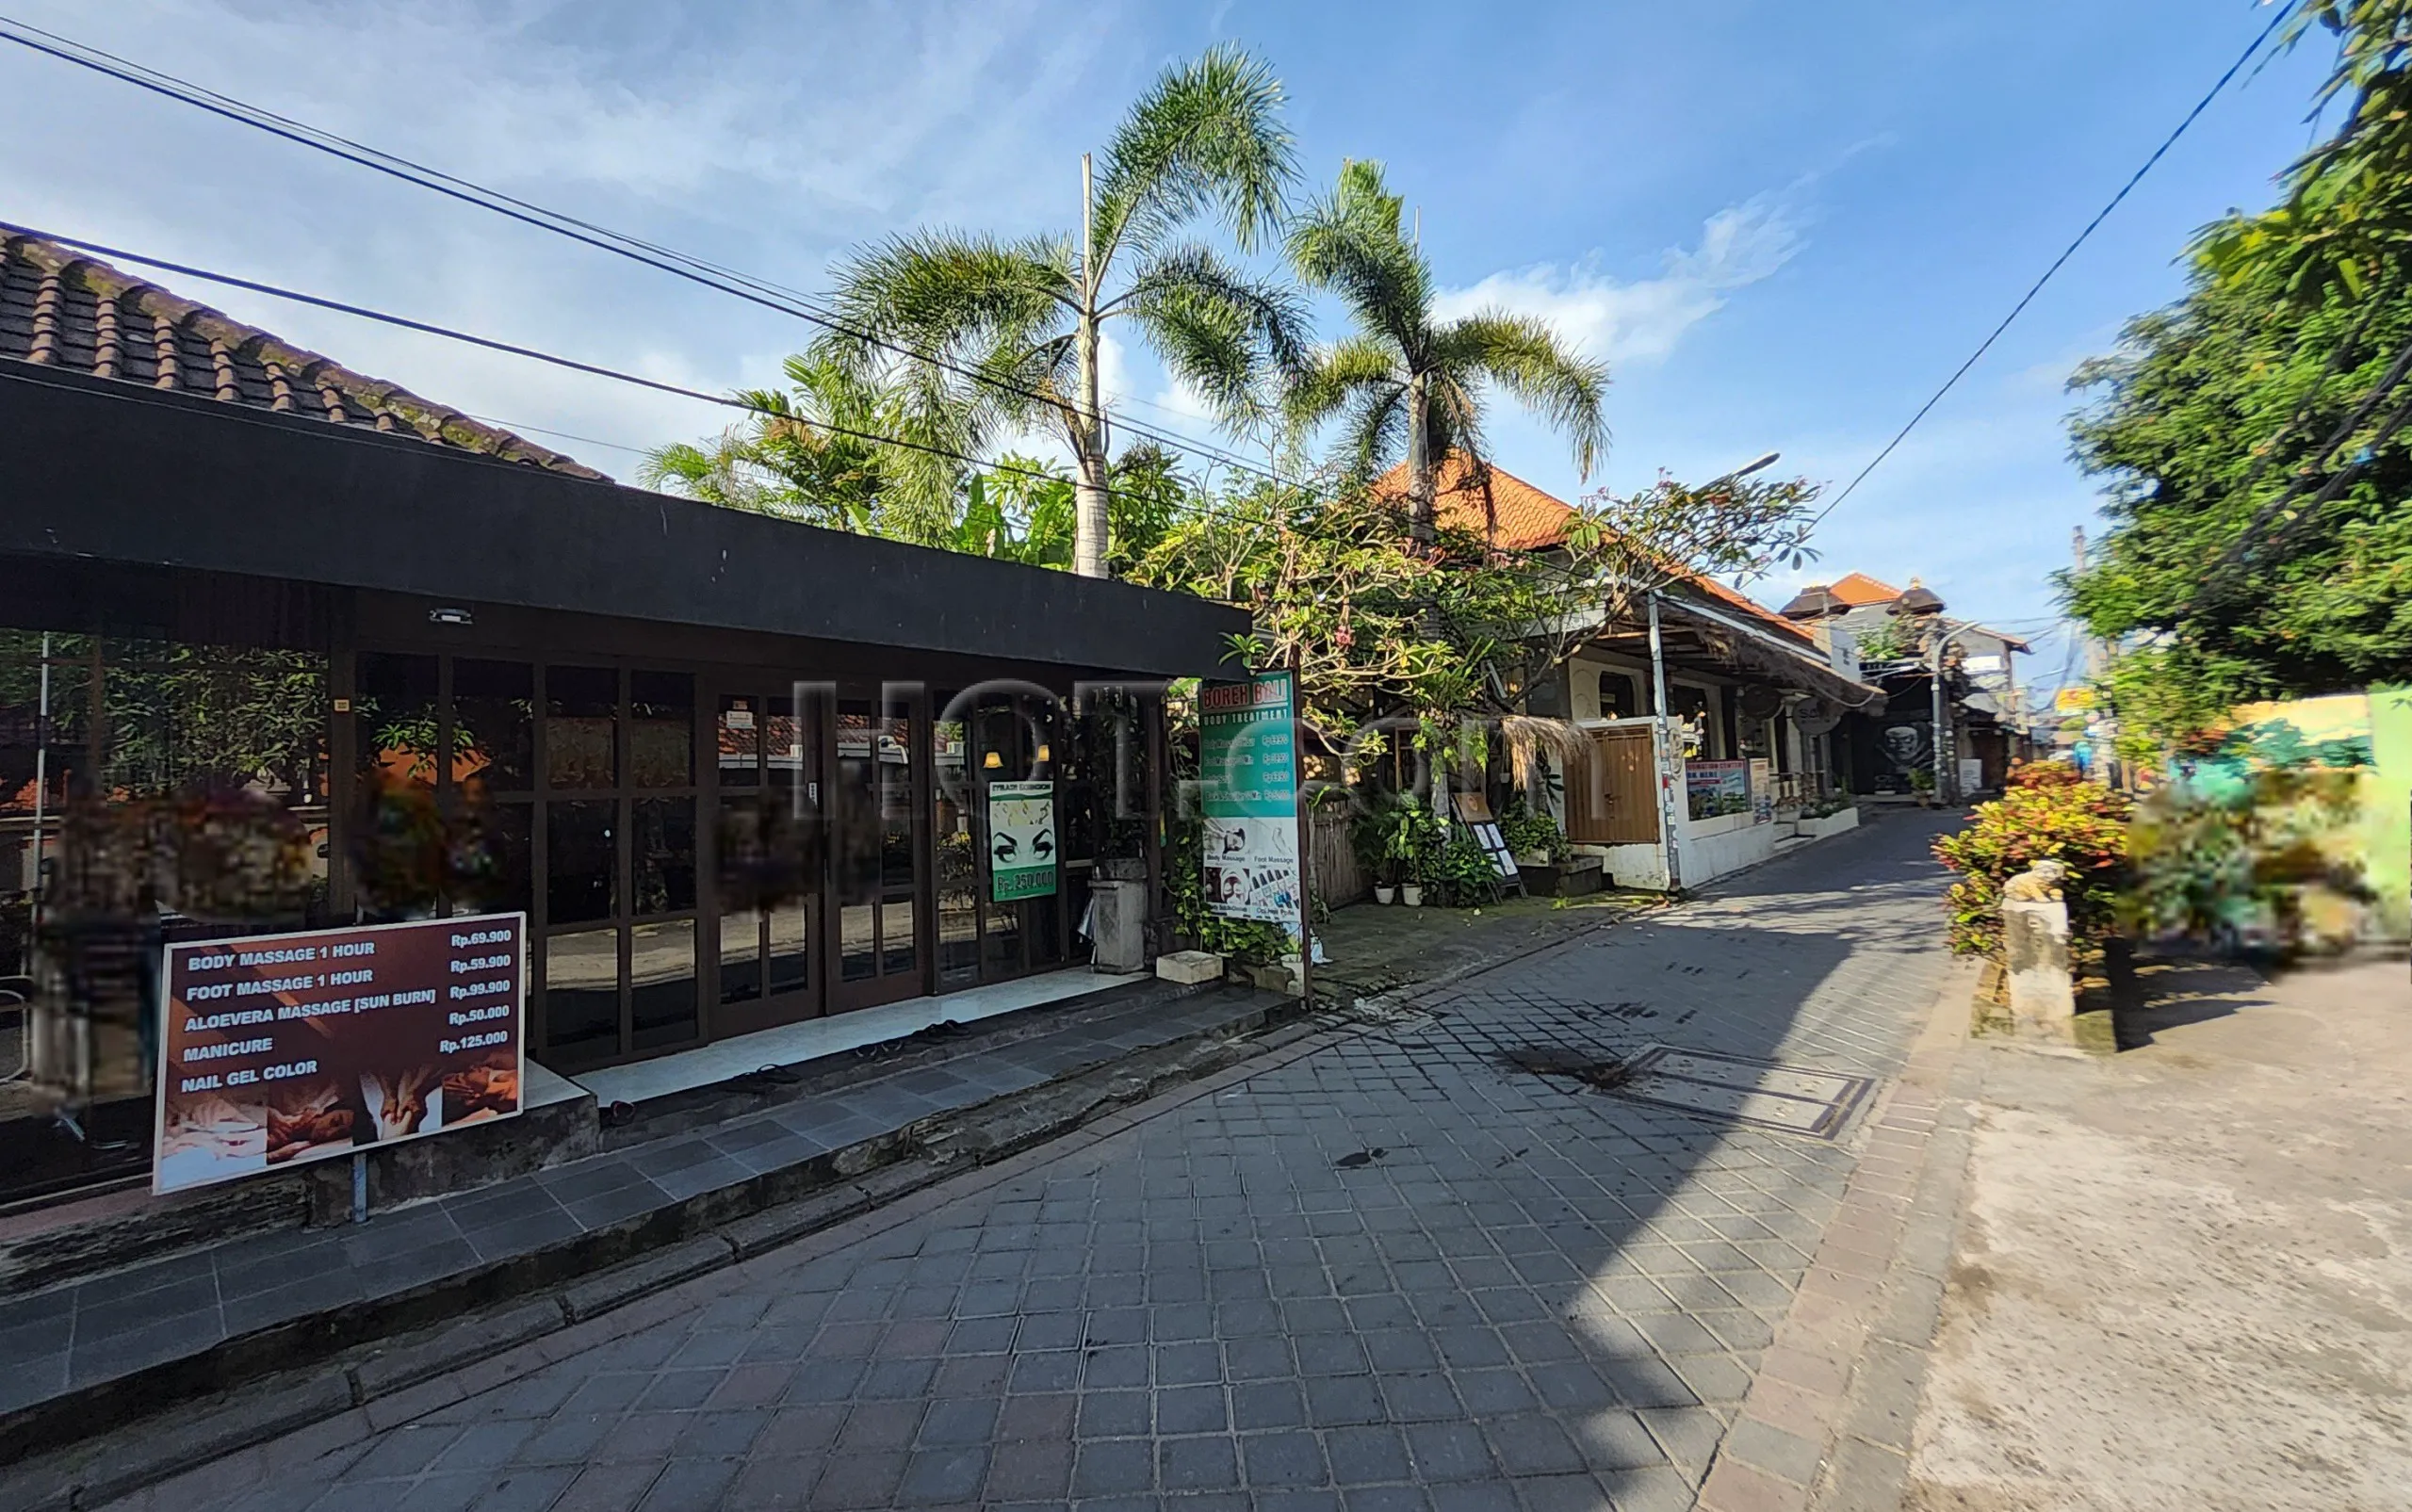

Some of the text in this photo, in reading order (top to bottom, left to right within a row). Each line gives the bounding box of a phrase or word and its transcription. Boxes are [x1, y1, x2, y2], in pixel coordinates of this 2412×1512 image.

[1203, 679, 1287, 708] BOREH BALI
[1204, 709, 1287, 725] BODY TREATMENT
[188, 930, 511, 970] BODY MASSAGE 1 HOUR Rp.69.900
[187, 955, 511, 1000] FOOT MASSAGE 1 HOUR Rp.59.900
[185, 981, 510, 1032] ALOEVERA MASSAGE [SUN BURN] Rp.99.900
[184, 1005, 509, 1062] MANICURE Rp.50.000
[182, 1031, 507, 1092] NAIL GEL COLOR Rp.125.000
